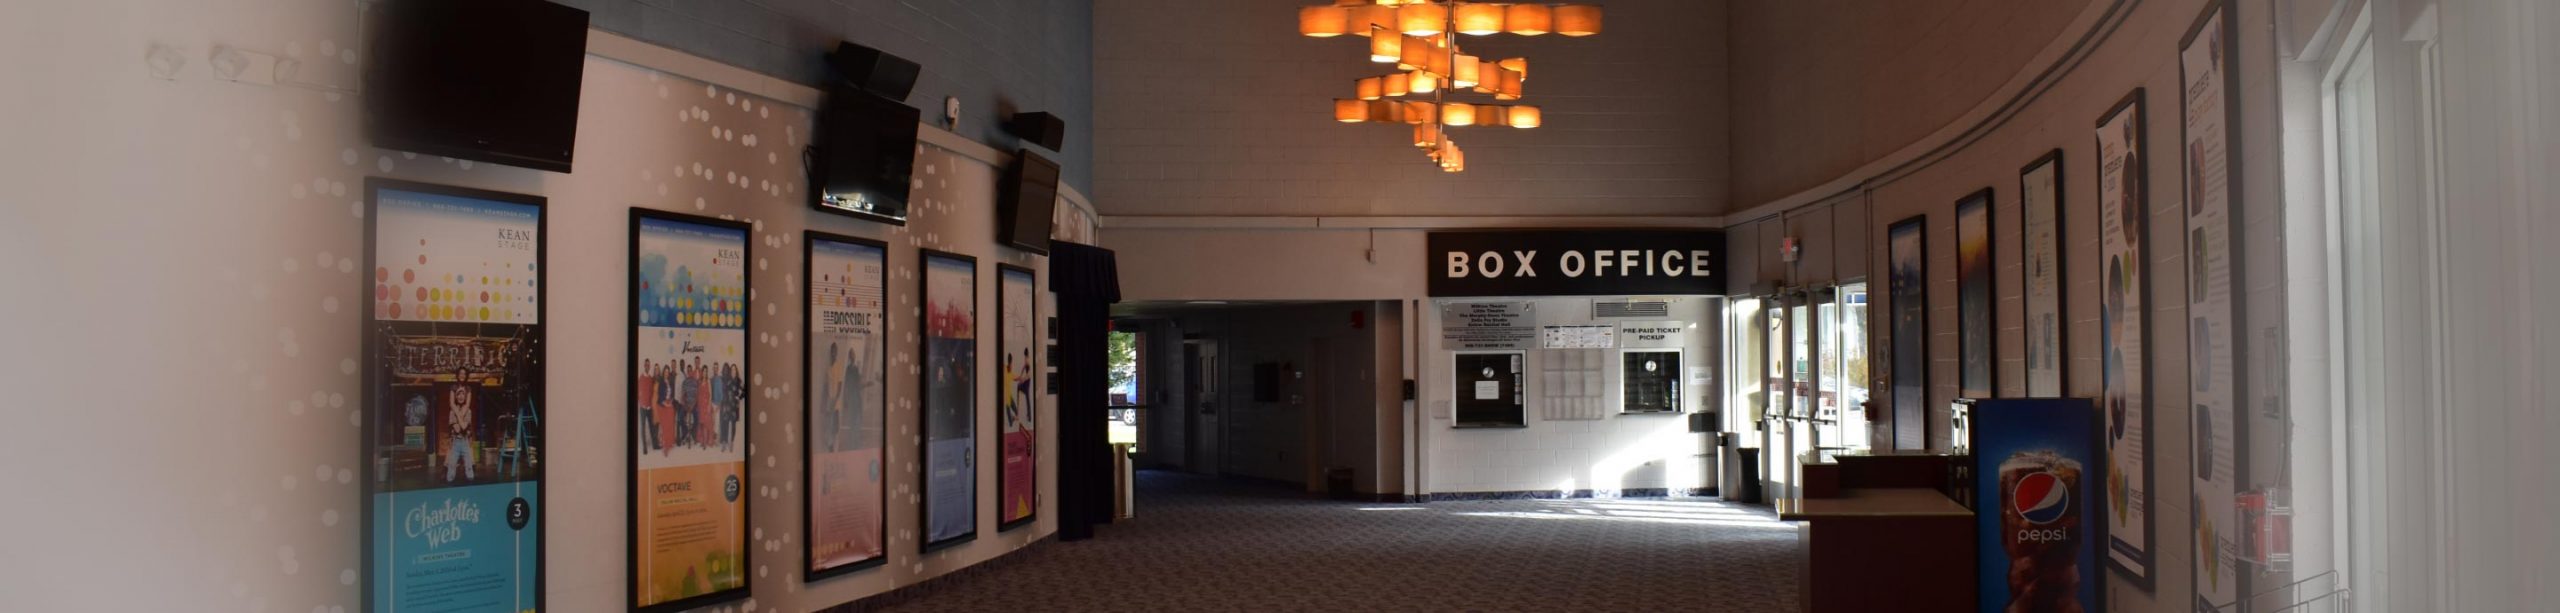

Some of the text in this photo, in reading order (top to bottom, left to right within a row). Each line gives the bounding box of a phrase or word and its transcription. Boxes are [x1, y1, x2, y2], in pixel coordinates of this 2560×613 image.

[498, 228, 530, 241] KEAN
[498, 241, 530, 250] STAGE
[718, 249, 740, 260] KEAN
[1447, 249, 1711, 279] BOX OFFICE
[405, 344, 507, 370] TERRIFIC
[657, 481, 692, 494] VOCTAVE
[726, 479, 738, 492] 25
[513, 503, 522, 518] 3
[405, 498, 480, 538] Charlotte's
[2017, 525, 2067, 545] pepsi
